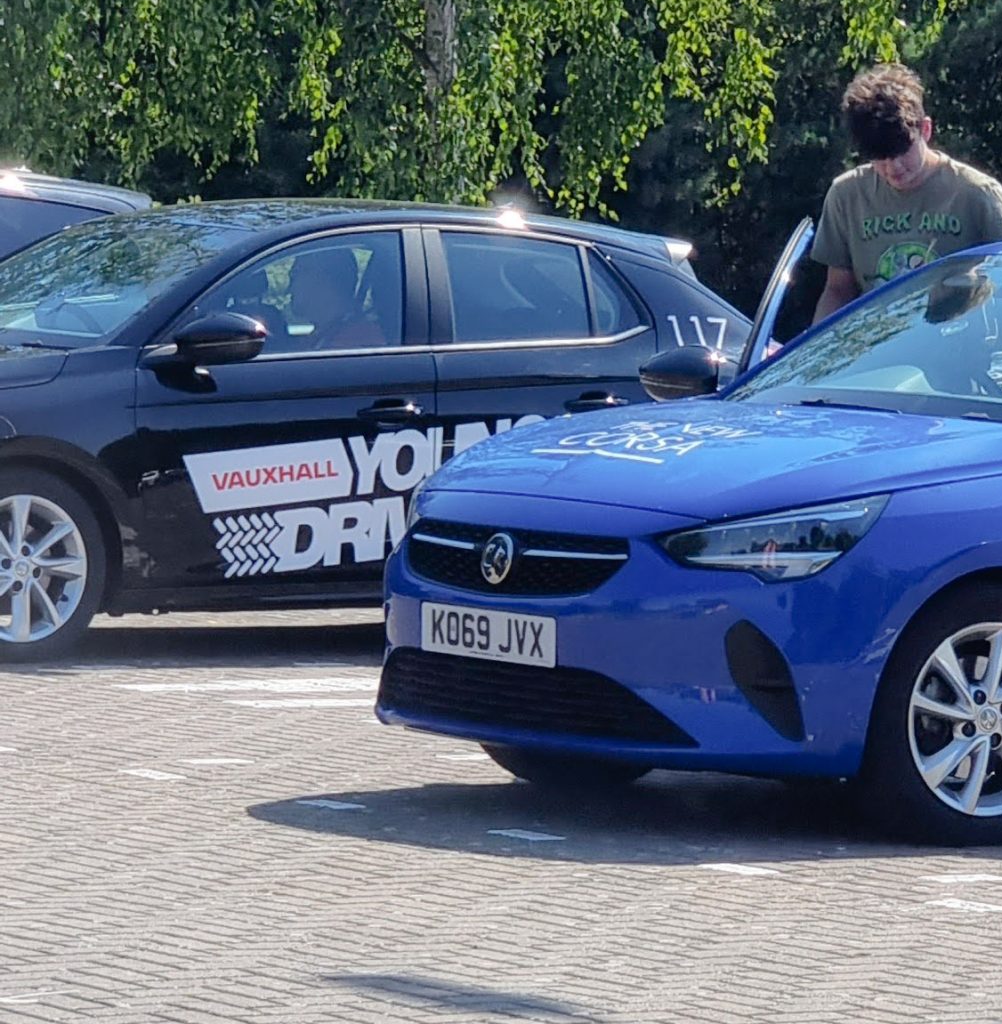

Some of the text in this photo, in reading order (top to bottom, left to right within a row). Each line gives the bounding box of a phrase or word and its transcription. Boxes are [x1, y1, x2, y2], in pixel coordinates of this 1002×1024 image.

[862, 212, 962, 240] RICK AND
[667, 315, 727, 350] 117
[558, 431, 706, 457] CORSA
[211, 460, 339, 492] VAUXHALL
[432, 608, 544, 658] KO69 JVX
